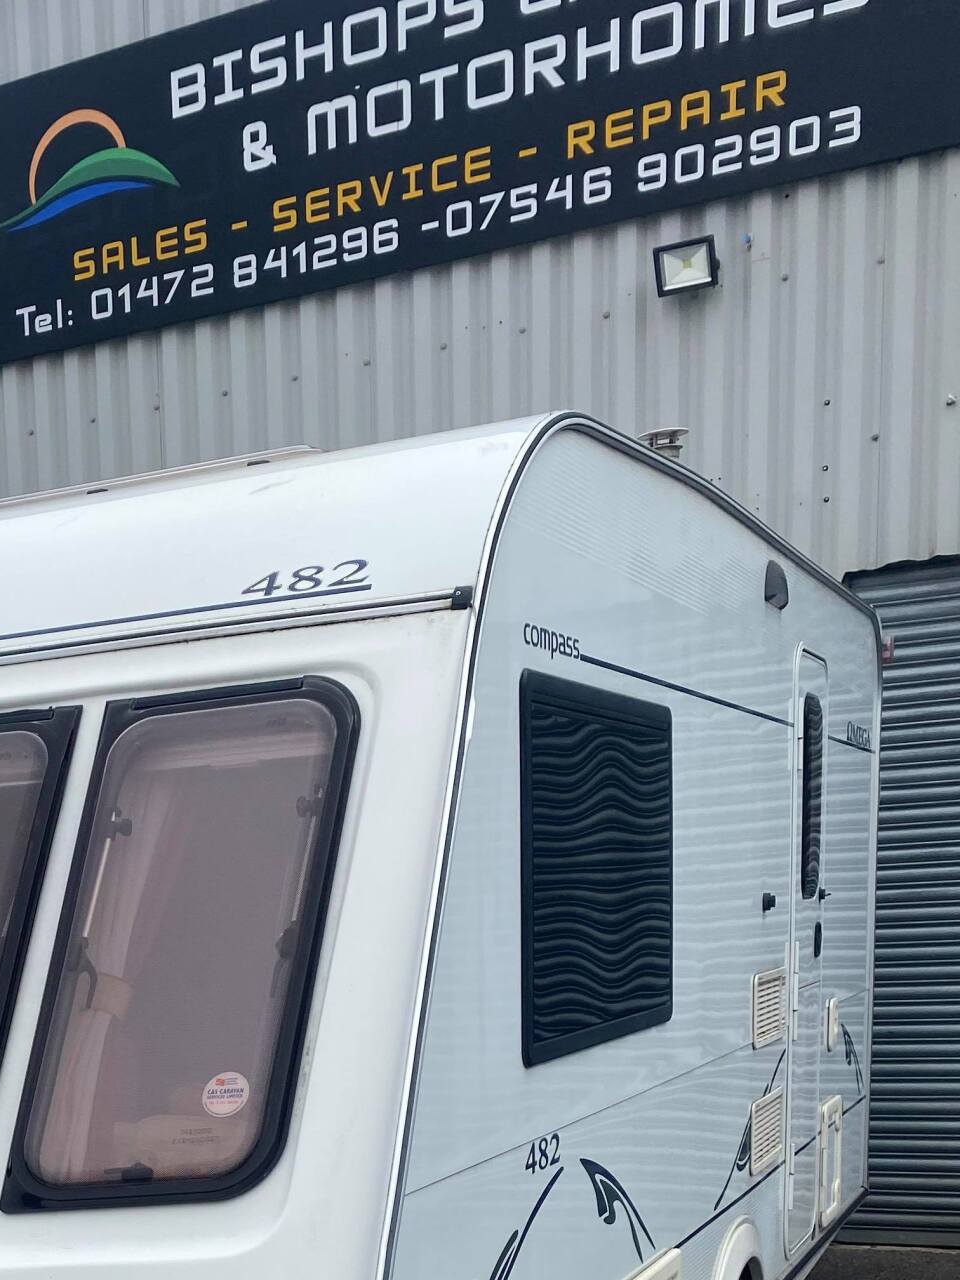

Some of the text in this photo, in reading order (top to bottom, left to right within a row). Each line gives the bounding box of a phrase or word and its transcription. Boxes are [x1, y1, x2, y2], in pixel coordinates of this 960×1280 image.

[170, 0, 484, 119] BISHOPS
[242, 0, 870, 172] & MOTORHOM
[15, 299, 73, 336] Tel:
[90, 262, 214, 320] 01472
[233, 218, 400, 289] 841296
[637, 105, 862, 192] 902903
[72, 218, 208, 281] SALES
[272, 146, 492, 233] SERVICE
[567, 70, 788, 159] REPAIR
[241, 558, 369, 597] 482
[523, 622, 580, 660] compass
[525, 1132, 561, 1175] 482
